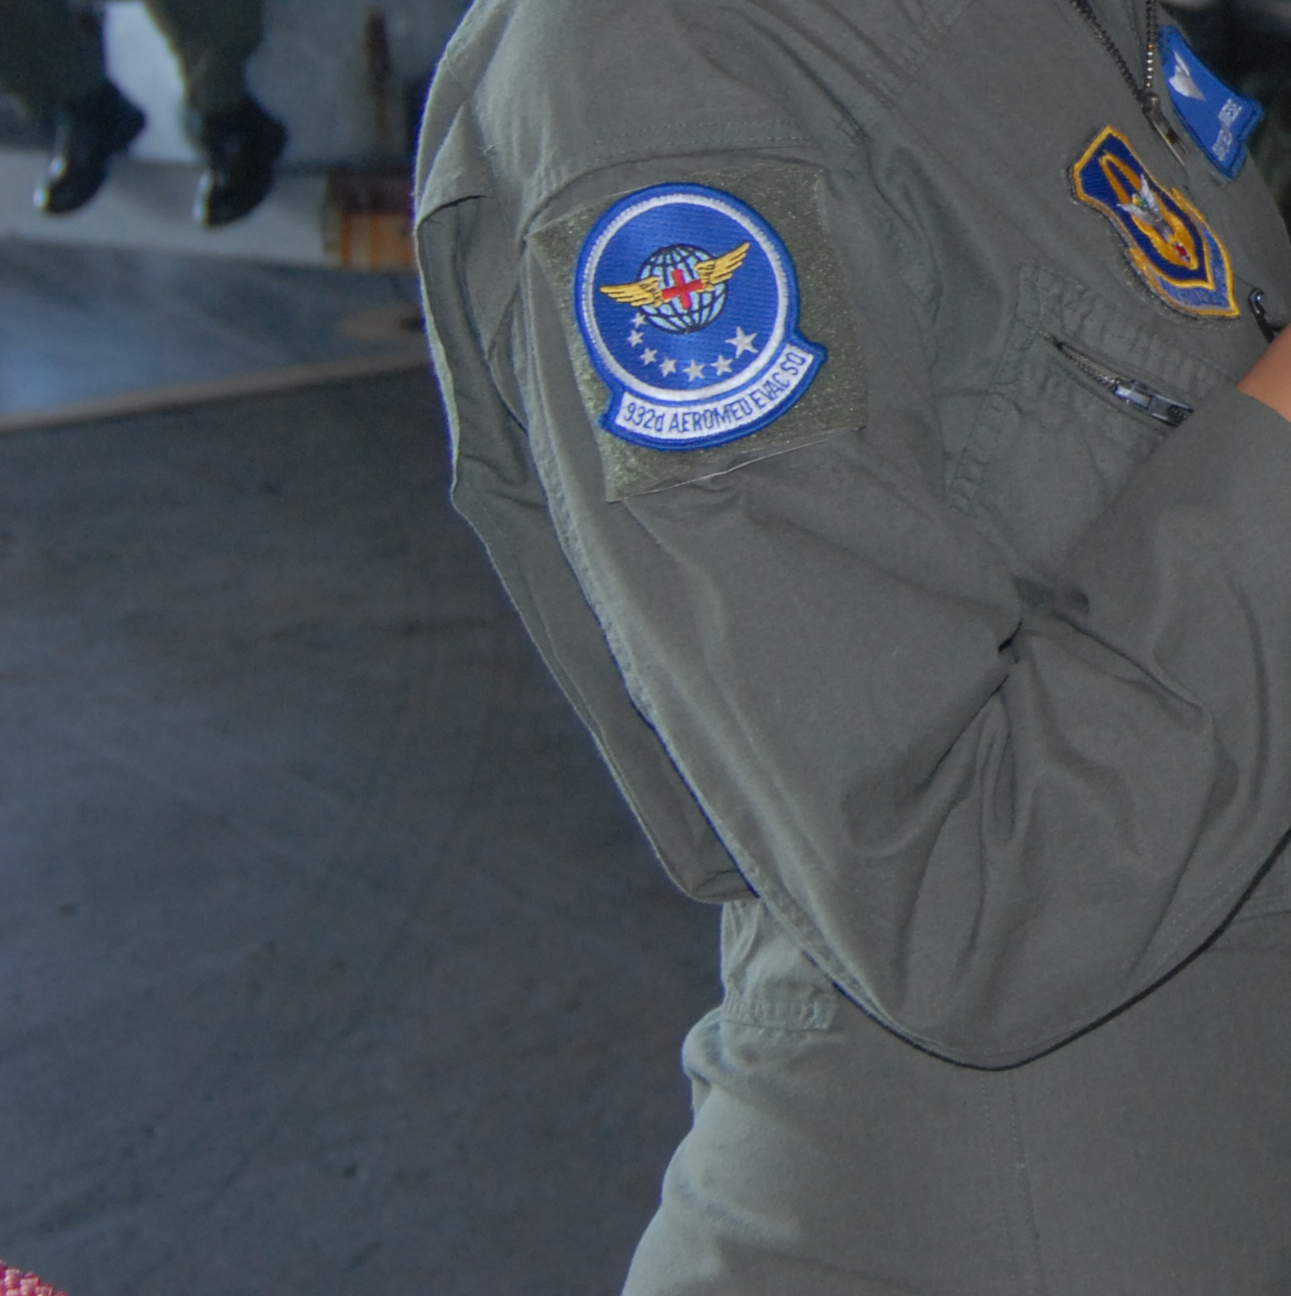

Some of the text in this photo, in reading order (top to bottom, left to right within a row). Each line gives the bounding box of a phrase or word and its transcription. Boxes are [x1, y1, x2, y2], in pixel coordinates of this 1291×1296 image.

[624, 402, 665, 432] 932d
[668, 397, 753, 433] AEROMED
[750, 373, 791, 410] EVAC
